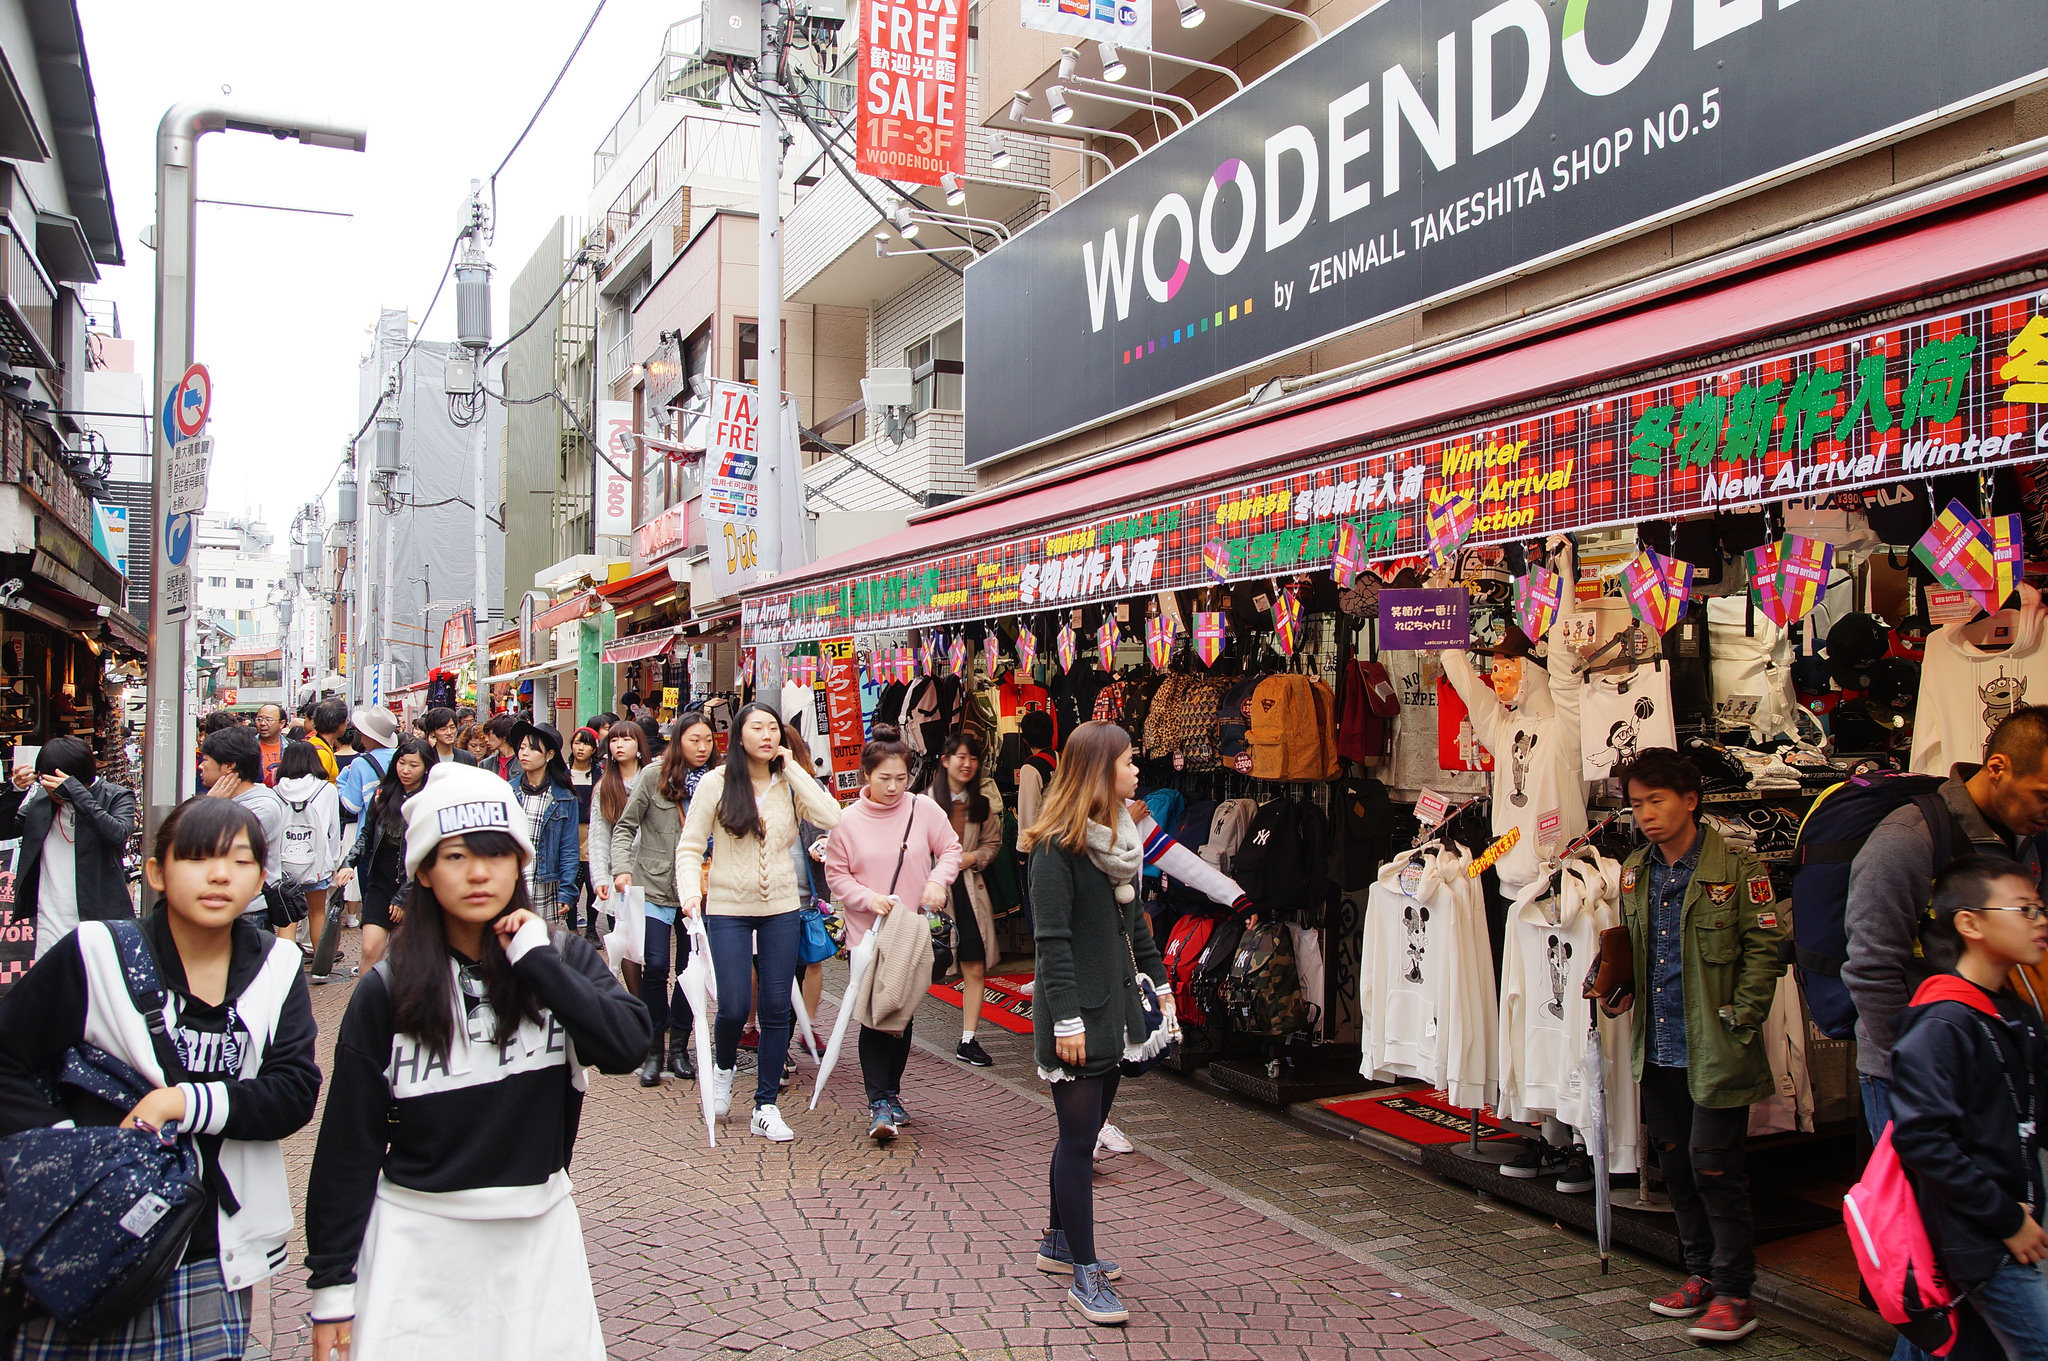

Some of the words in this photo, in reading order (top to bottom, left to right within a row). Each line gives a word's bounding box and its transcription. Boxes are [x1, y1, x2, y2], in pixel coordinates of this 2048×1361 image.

[870, 2, 958, 60] FREE
[867, 72, 954, 127] SALE
[866, 117, 954, 157] 1F-3F
[1083, 0, 1800, 333] WOODENDO
[1274, 280, 1294, 311] by
[1308, 239, 1405, 294] ZENMALL
[1411, 170, 1546, 251] TAKESHITA
[1553, 127, 1633, 193] SHOP
[1644, 87, 1720, 156] NO.5
[1629, 333, 1978, 477] 冬物新作入荷
[716, 422, 758, 453] FRE
[1442, 439, 1529, 477] Winter
[1703, 472, 1765, 503] New
[1770, 442, 1887, 491] Arrival
[1902, 431, 2022, 471] Winter
[1216, 489, 1291, 524] 冬物新作多数
[1294, 464, 1426, 522] 冬物新作入荷
[1479, 459, 1574, 504] Arrival
[1862, 484, 1914, 509] FILA
[1470, 506, 1535, 535] ection
[1951, 527, 1973, 555] arrival
[1994, 548, 2012, 560] rival
[976, 562, 1000, 577] Winter
[982, 577, 996, 590] New
[996, 573, 1020, 588] Arrival
[1019, 538, 1159, 604] 冬物新作入荷
[1797, 566, 1821, 581] arrival
[742, 602, 759, 624] New
[759, 596, 790, 622] Arrival
[989, 589, 1019, 604] Collection
[754, 623, 781, 643] Winter
[782, 616, 830, 640] Collection
[824, 641, 852, 658] 3F
[1402, 672, 1420, 689] NO
[827, 664, 853, 746] アウトレット
[1404, 692, 1439, 707] EXPE
[833, 744, 862, 759] OUTLET
[440, 802, 508, 833] MARVEL
